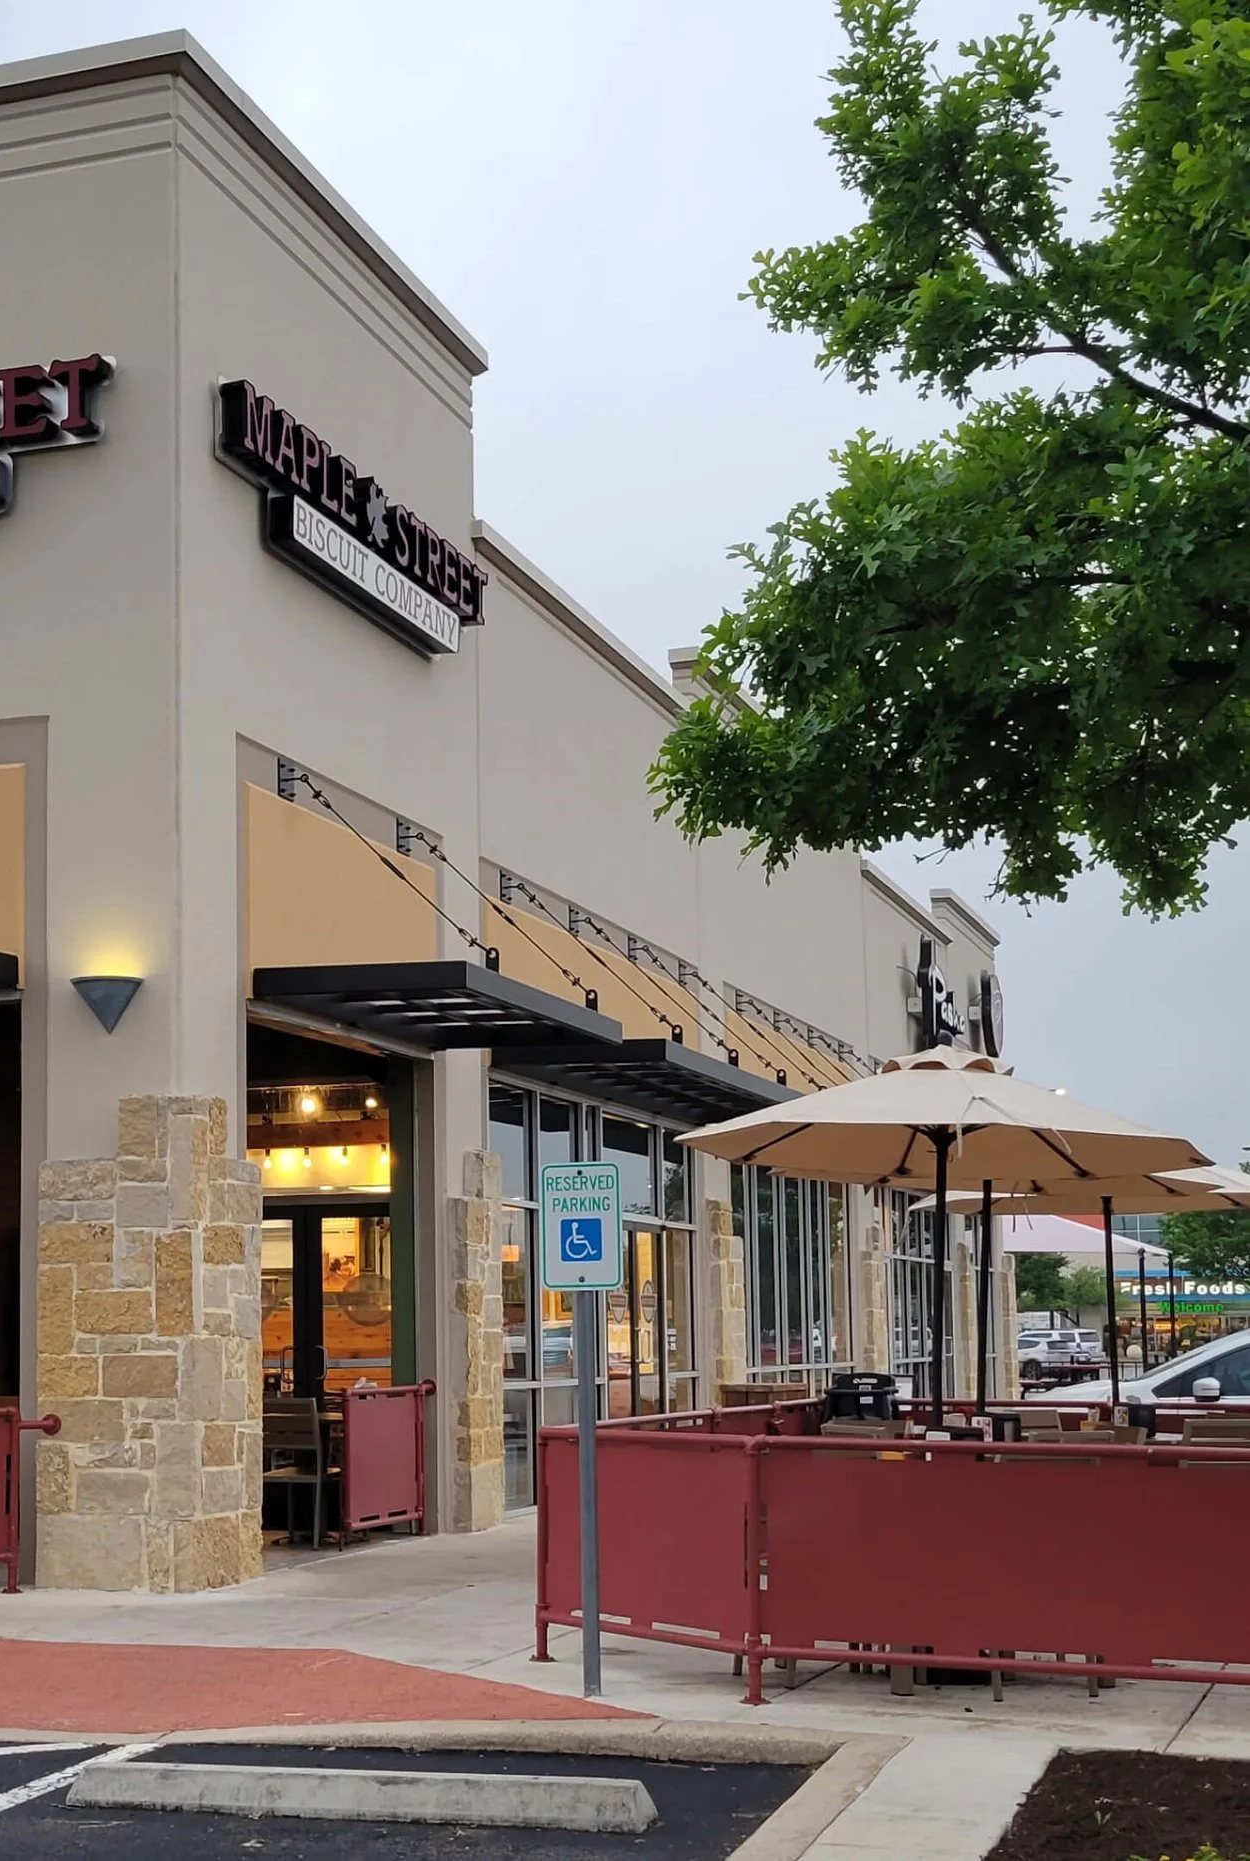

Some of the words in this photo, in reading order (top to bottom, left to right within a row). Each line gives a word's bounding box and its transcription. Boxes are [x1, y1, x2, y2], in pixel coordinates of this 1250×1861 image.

[243, 379, 358, 527] MAPLE
[394, 504, 488, 626] STREET
[295, 501, 369, 583] BISCUIT
[374, 563, 457, 645] COMPANY
[546, 1174, 615, 1192] RESERVED
[552, 1196, 611, 1213] PARKING
[1184, 1281, 1246, 1295] Foods
